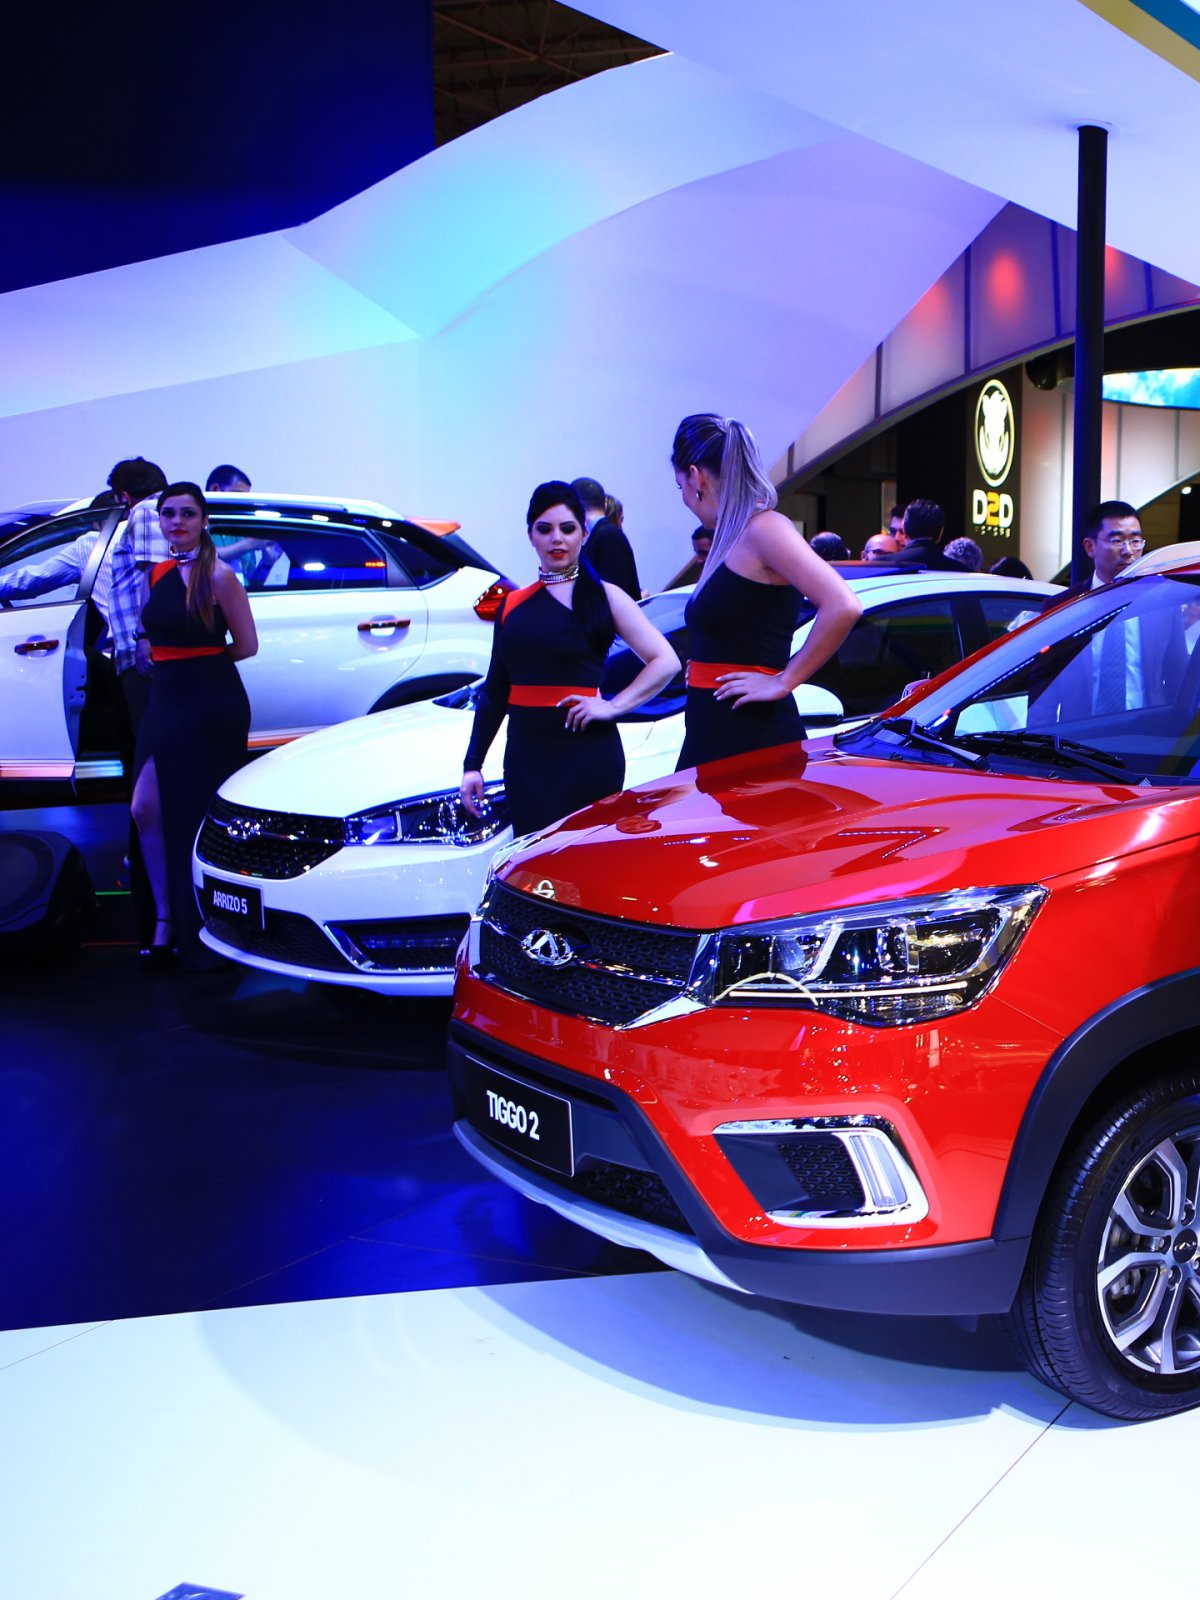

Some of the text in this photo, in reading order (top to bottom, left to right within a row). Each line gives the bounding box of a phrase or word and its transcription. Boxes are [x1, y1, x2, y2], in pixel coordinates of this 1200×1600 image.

[972, 488, 1013, 529] D2D
[213, 889, 249, 915] ARRIZO 5
[486, 1089, 541, 1141] TIGGO 2
